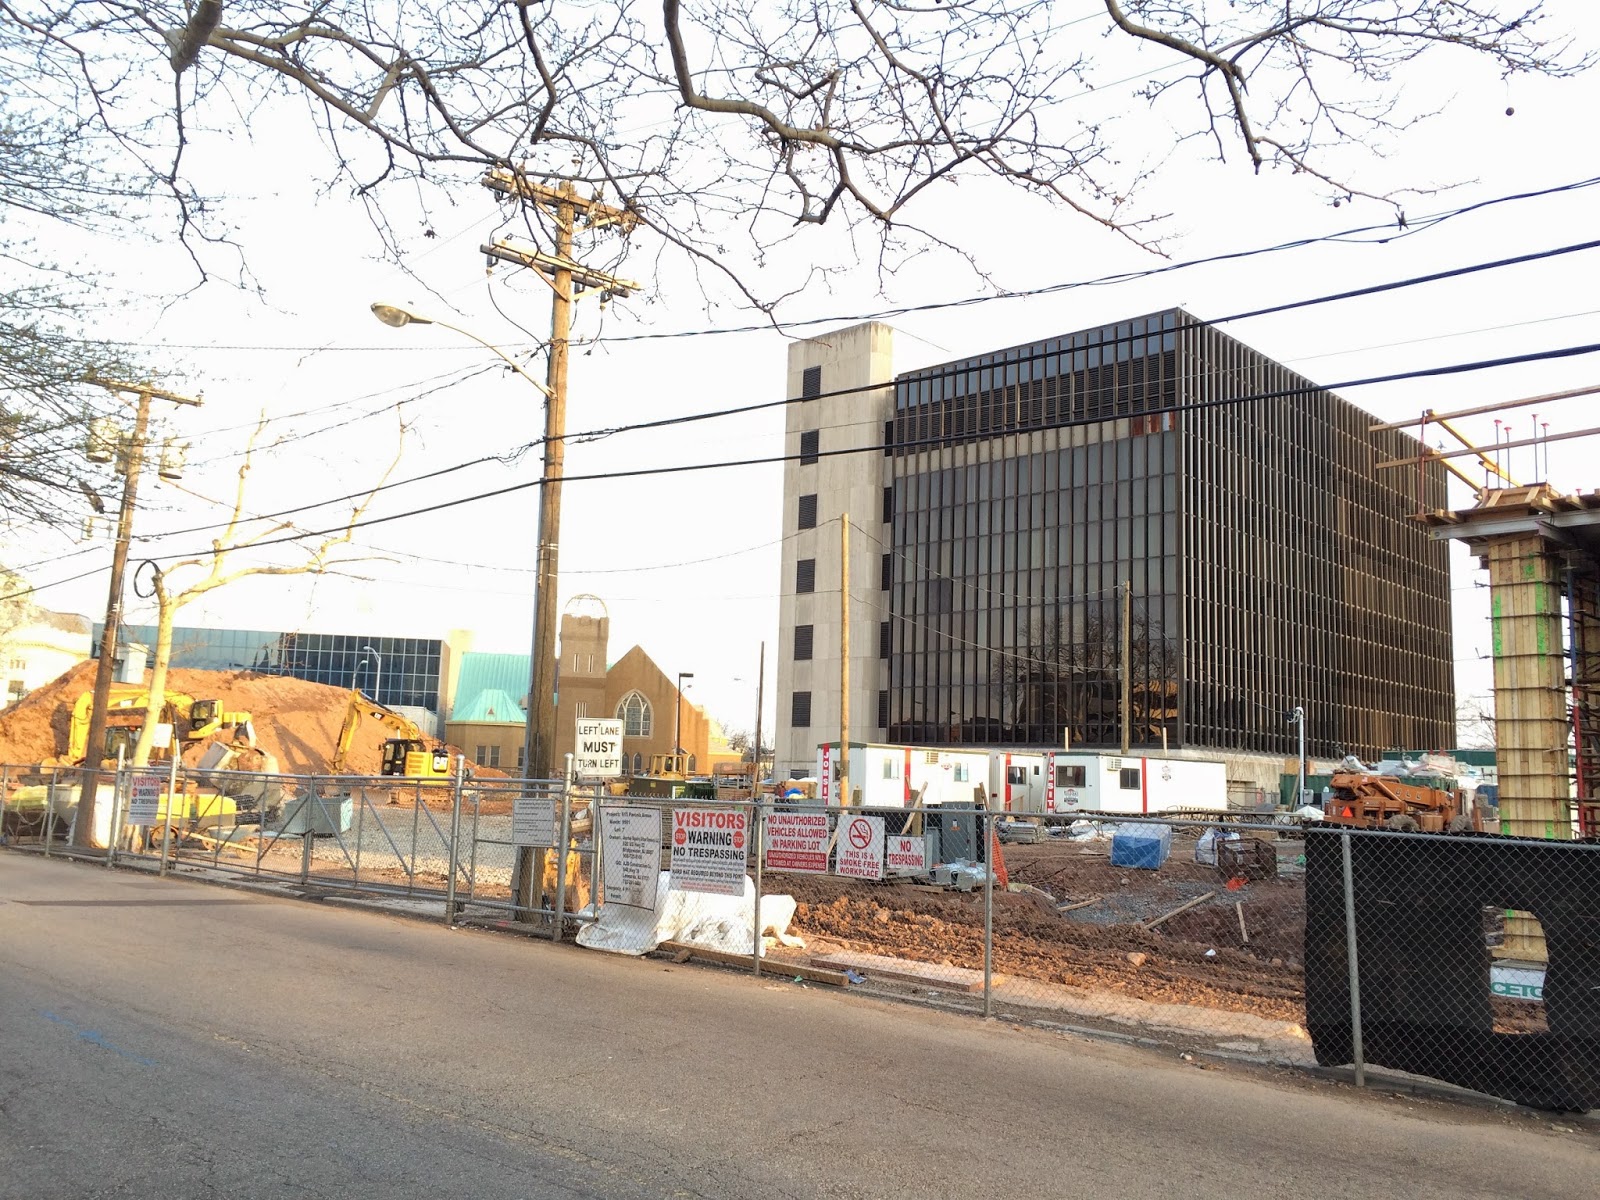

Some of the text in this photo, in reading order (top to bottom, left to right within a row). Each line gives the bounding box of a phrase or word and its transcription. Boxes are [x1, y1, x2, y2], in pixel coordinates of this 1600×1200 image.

[578, 726, 620, 736] LEFT LANE
[584, 741, 616, 753] MUST
[578, 759, 619, 768] TURN LEFT
[675, 812, 744, 829] VISITORS
[768, 815, 826, 826] NO UNAUTHORIZED
[688, 831, 732, 846] WARNING
[767, 827, 827, 839] VEHICLES ALLOWED
[772, 839, 820, 850] IN PARKING LOT
[900, 840, 911, 852] NO
[674, 846, 744, 860] NO TRESPASSING
[840, 859, 862, 867] SMOKE
[888, 854, 923, 867] TRESPASSING
[840, 866, 878, 878] WORKPLACE
